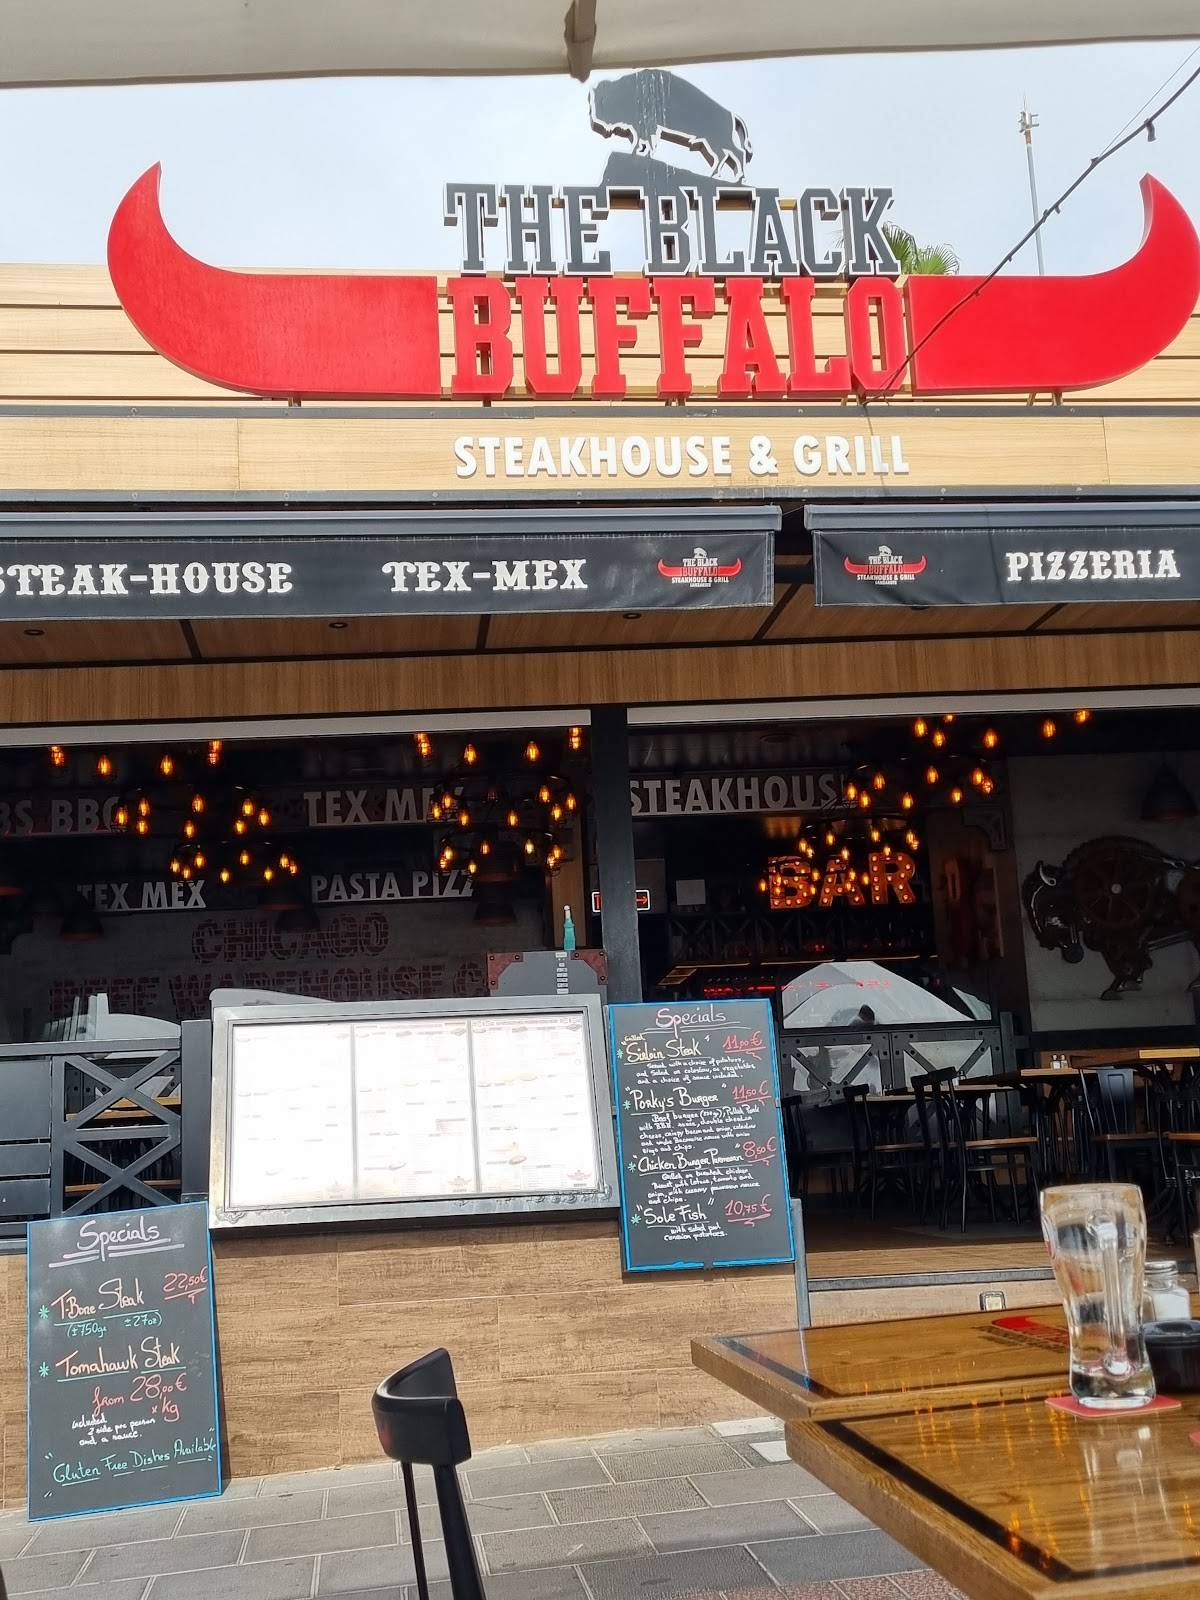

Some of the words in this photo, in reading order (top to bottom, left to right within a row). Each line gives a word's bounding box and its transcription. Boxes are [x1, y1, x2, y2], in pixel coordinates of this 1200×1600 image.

[443, 182, 612, 276] THE
[643, 186, 902, 280] BLACK
[447, 276, 908, 399] BUFFALO
[453, 435, 732, 478] STEAKHOUSE
[748, 435, 779, 474] &
[793, 435, 910, 476] GRILL
[381, 558, 589, 593] TEX-MEX
[682, 558, 697, 567] THE
[697, 558, 718, 567] BLACK
[682, 567, 718, 577] BUFFALO
[868, 556, 882, 565] THE
[883, 556, 903, 565] BLACK
[868, 564, 903, 575] BUFFALO
[1005, 549, 1181, 582] PIZZERIA
[0, 562, 294, 596] TEAK-HOUSE
[671, 576, 707, 584] STEAKHOUSE
[304, 788, 370, 826] TEX
[630, 774, 843, 814] STEAKHOUS
[141, 880, 206, 909] MEX
[311, 873, 401, 903] PASTA
[767, 853, 917, 910] BAR
[655, 1003, 727, 1039] Specials
[637, 1156, 677, 1174] Chicken
[672, 1152, 710, 1170] Burger
[643, 1206, 677, 1225] Sole
[674, 1203, 708, 1221] Fish
[76, 1216, 160, 1262] Specials
[98, 1278, 144, 1310] Steak
[56, 1345, 138, 1377] Tomahawk
[140, 1336, 180, 1368] Steak
[92, 1386, 125, 1418] from
[53, 1461, 101, 1483] Gluten
[100, 1453, 128, 1471] Free
[129, 1449, 170, 1468] Dishes
